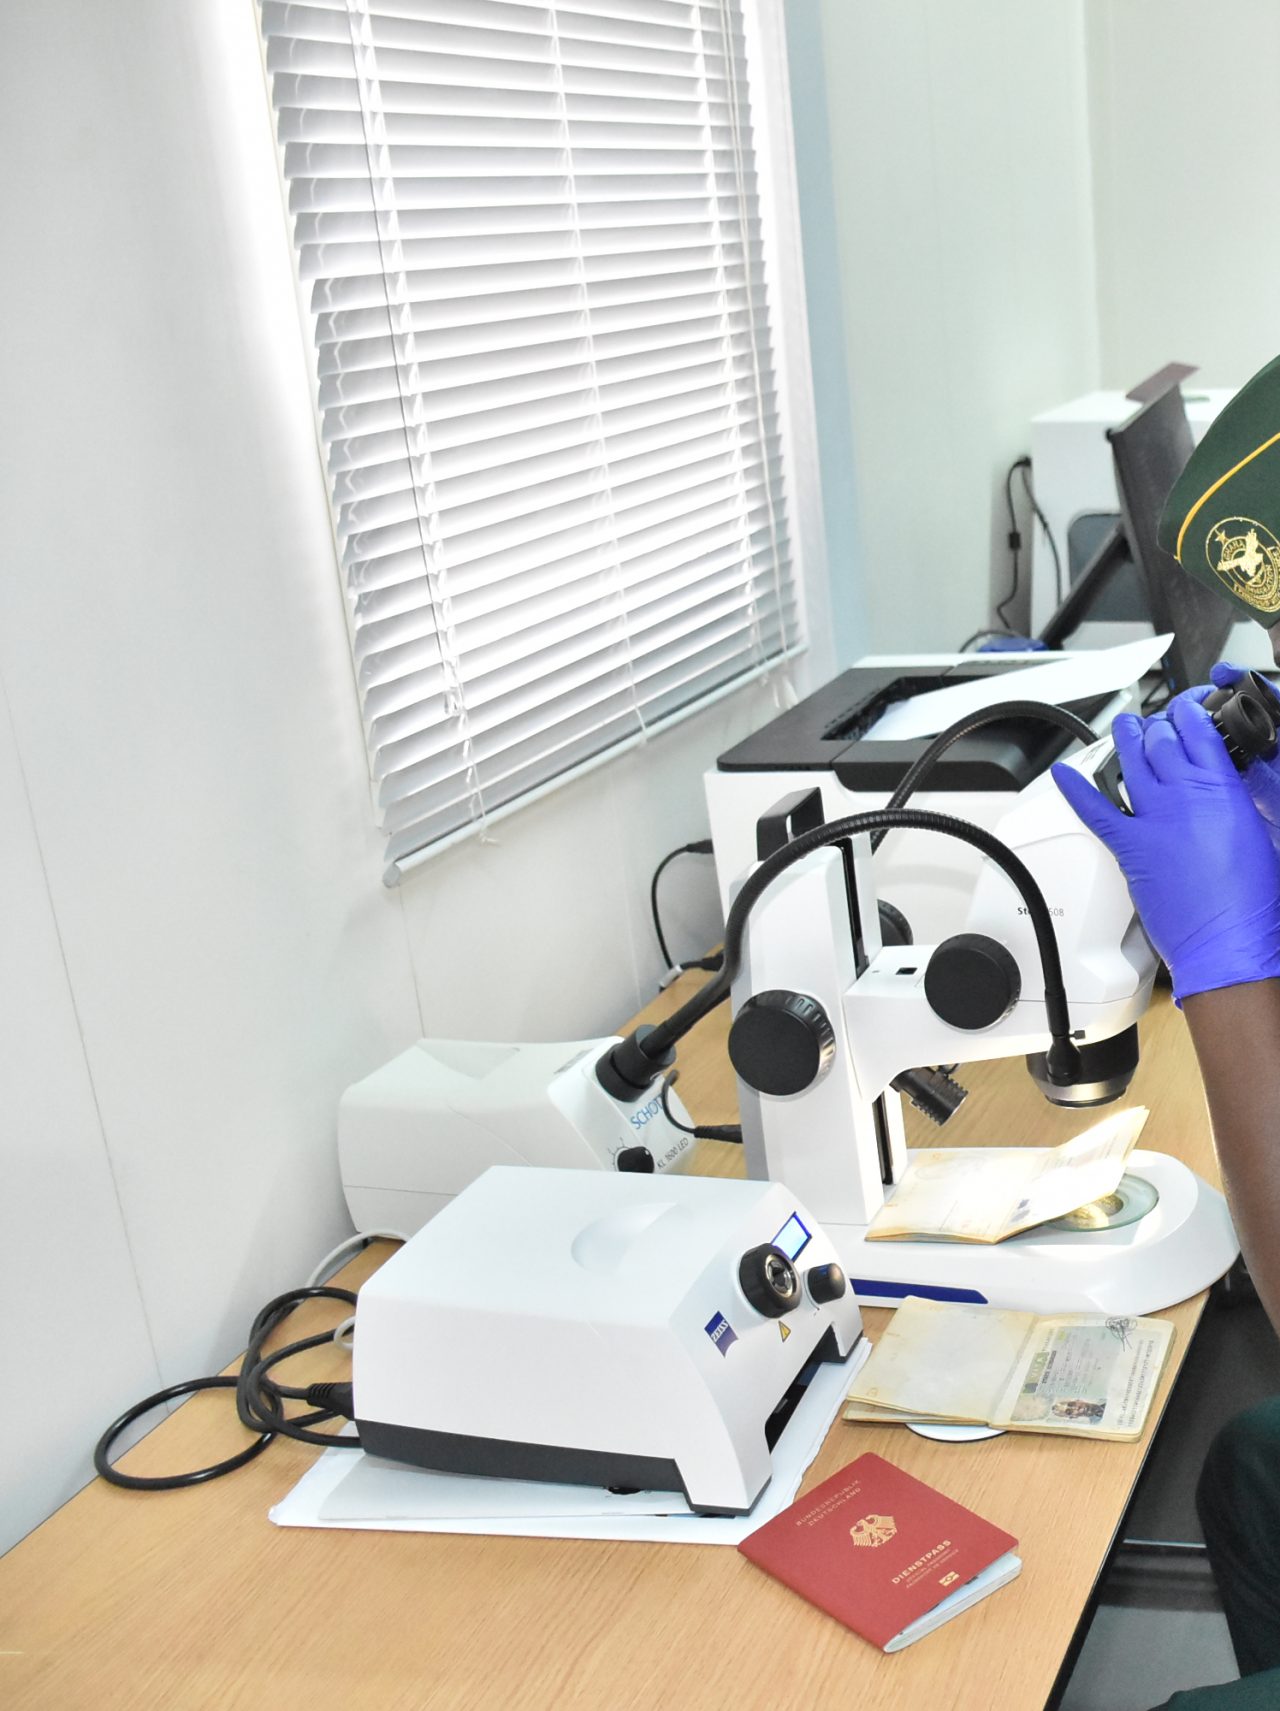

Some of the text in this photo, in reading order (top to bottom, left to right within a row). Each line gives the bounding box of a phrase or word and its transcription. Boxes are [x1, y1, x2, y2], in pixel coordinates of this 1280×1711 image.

[630, 1093, 664, 1130] SCHOT
[678, 1137, 690, 1152] LED
[710, 1319, 730, 1343] ZEISS
[808, 1487, 862, 1526] DEUTSCHLAND
[891, 1539, 952, 1585] DIENSTPASS
